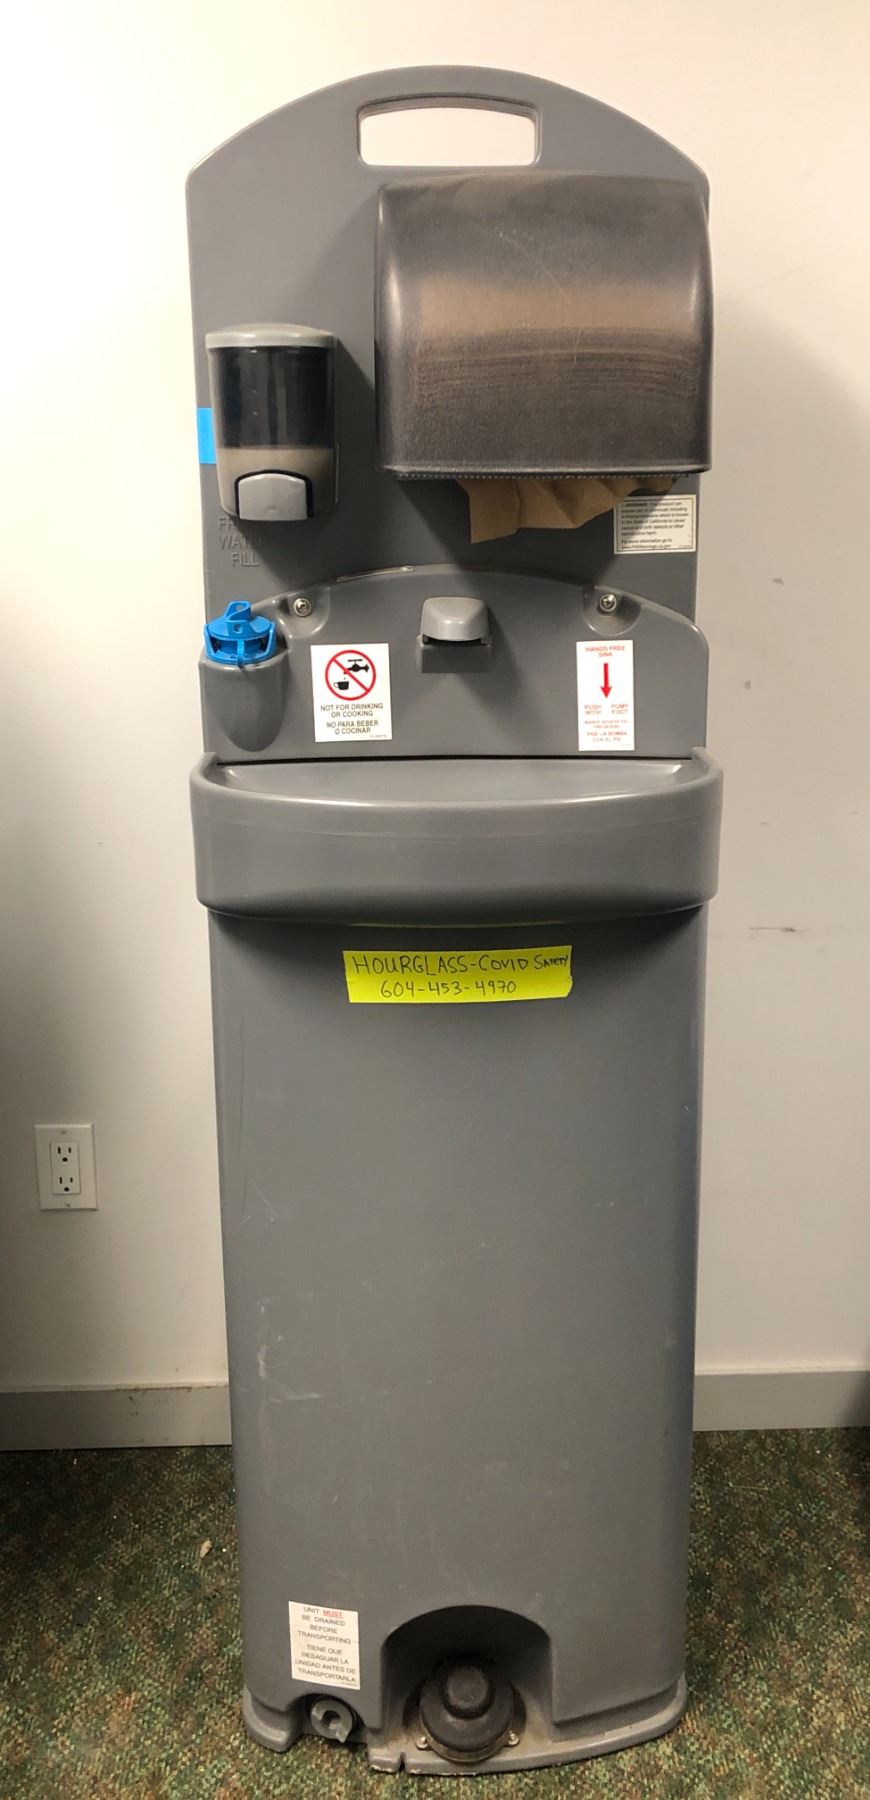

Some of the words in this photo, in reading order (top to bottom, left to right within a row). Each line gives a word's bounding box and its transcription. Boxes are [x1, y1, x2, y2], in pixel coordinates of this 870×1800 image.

[231, 551, 259, 568] FILL
[320, 704, 334, 712] NOT
[336, 703, 350, 711] FOR
[351, 702, 383, 710] DRINKING
[342, 710, 373, 718] COOKING
[326, 721, 336, 729] NO
[337, 720, 355, 728] PARA
[356, 719, 379, 727] BEBER
[341, 726, 371, 735] COCINAR
[380, 979, 518, 998] 604-453-4970
[303, 1606, 320, 1614] UNIT
[323, 1609, 343, 1617] MUST
[314, 1616, 346, 1626] DRAINED
[309, 1624, 338, 1634] BEFORE
[297, 1630, 351, 1645] TRANSPORTING
[307, 1644, 326, 1653] TIENE
[301, 1651, 339, 1663] DESAGUAR
[294, 1659, 321, 1668] UNIDAD
[322, 1664, 345, 1672] ANTES
[297, 1667, 356, 1682] TRANSPORTARLA
